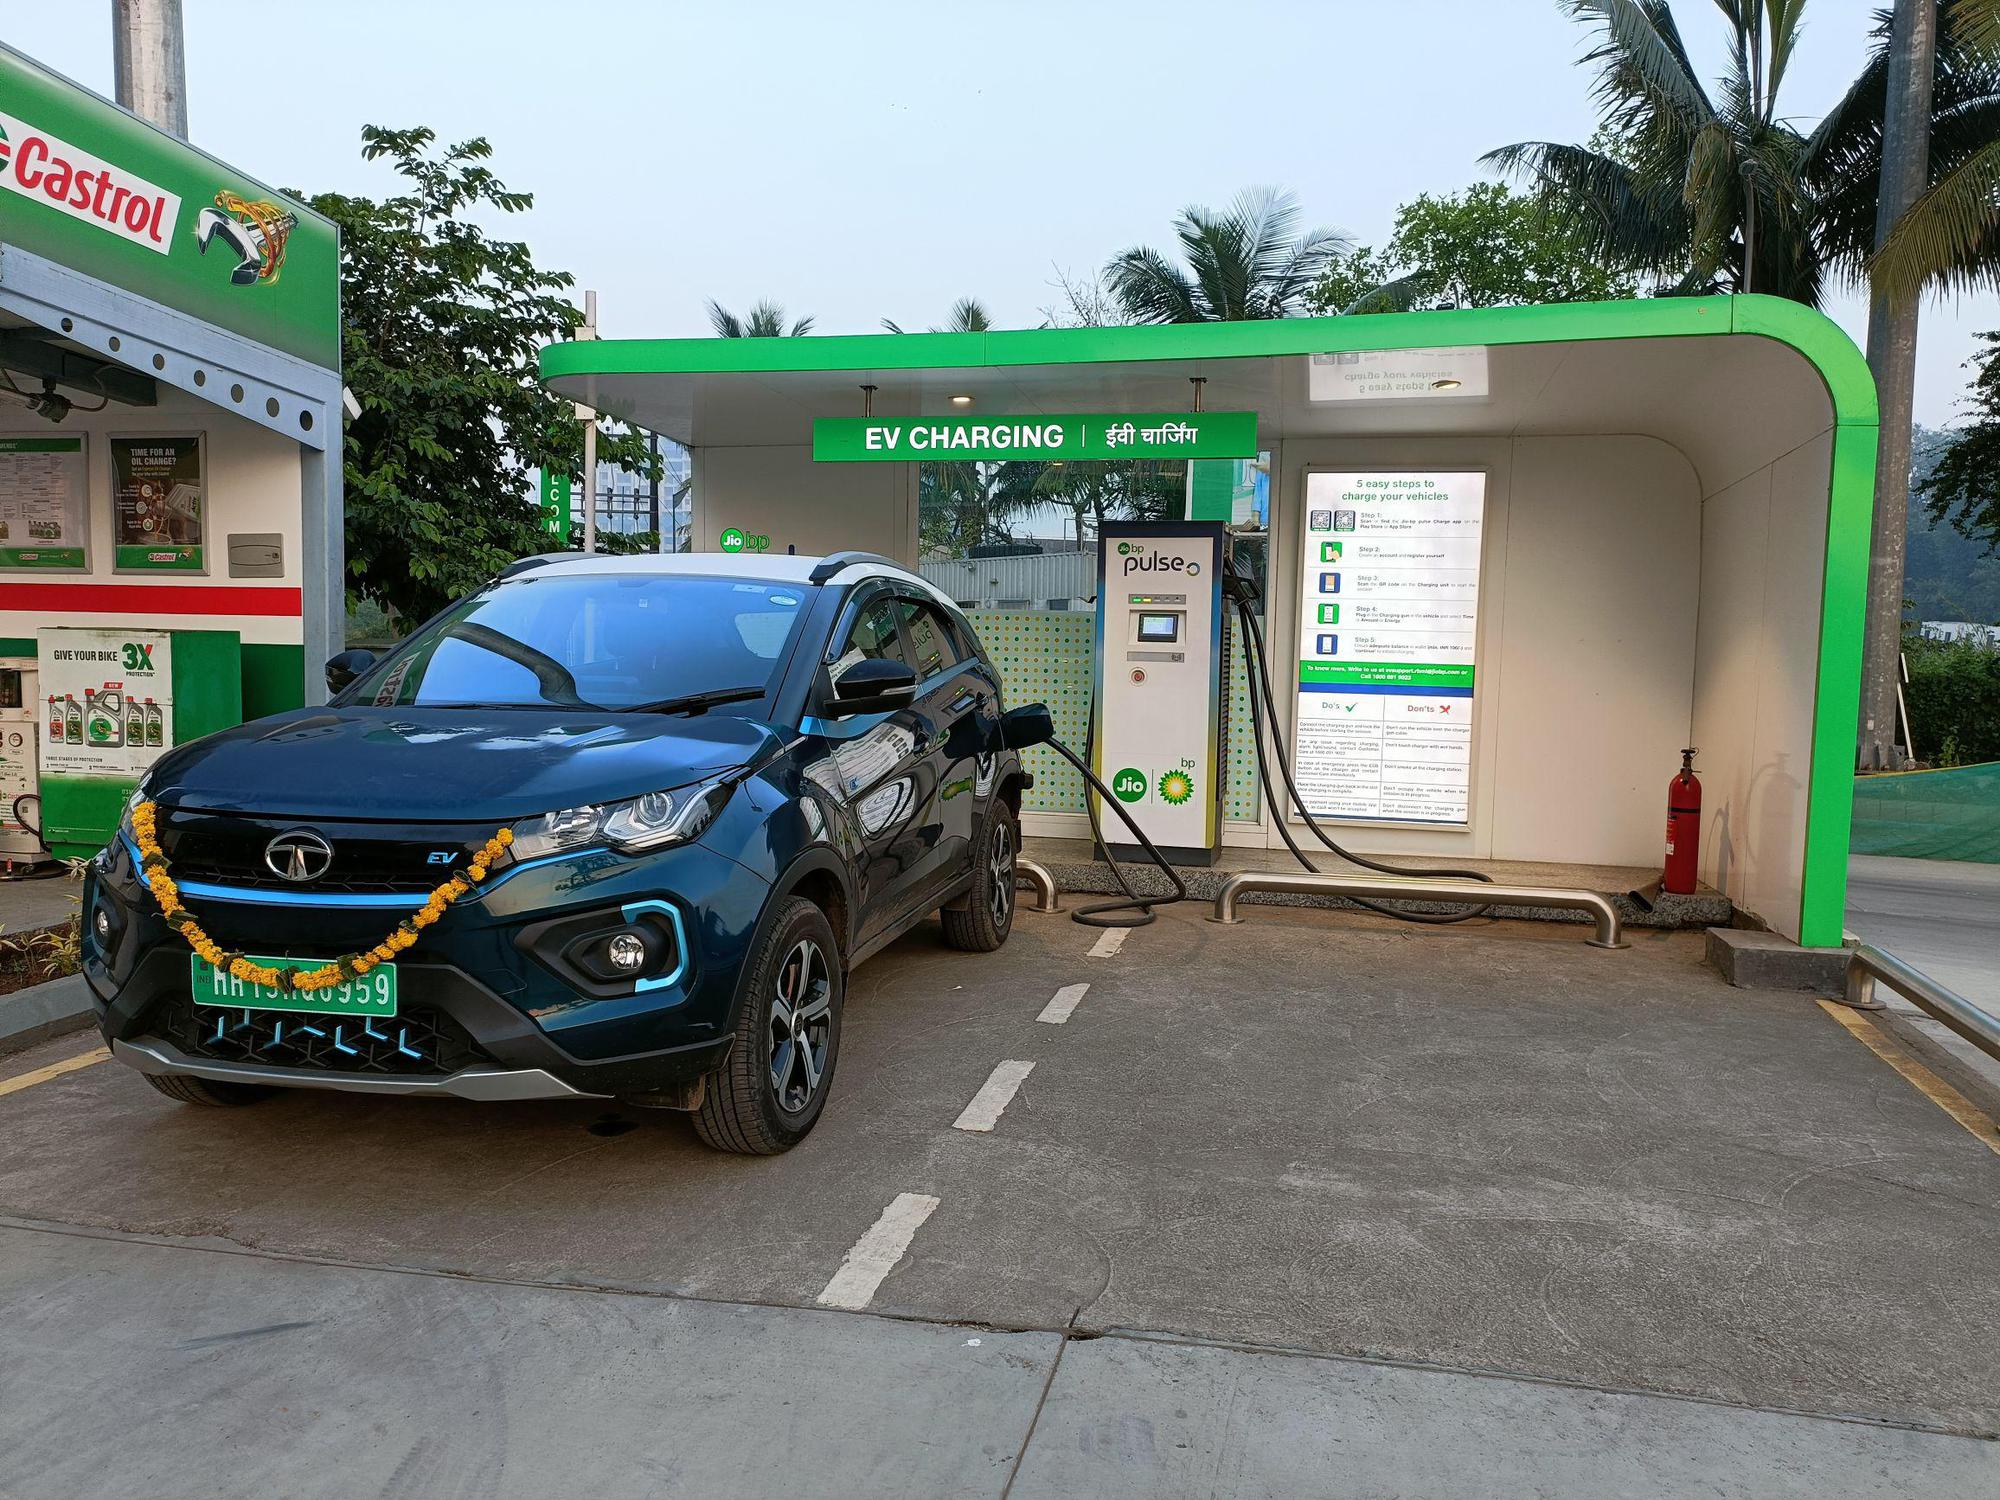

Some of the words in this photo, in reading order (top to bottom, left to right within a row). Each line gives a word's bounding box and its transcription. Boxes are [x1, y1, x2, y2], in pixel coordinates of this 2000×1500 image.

[14, 137, 165, 243] Castrol
[865, 427, 901, 450] EV
[909, 424, 1064, 449] CHARGING
[1105, 423, 1136, 448] ईवी
[1140, 422, 1198, 444] चार्जिंग
[1366, 481, 1389, 489] easy
[1393, 480, 1421, 489] steps
[1342, 492, 1377, 502] charge
[1380, 493, 1403, 502] your
[1406, 492, 1449, 500] vehicles
[723, 535, 741, 545] Jio
[746, 531, 770, 553] bp
[1119, 544, 1129, 552] Jio
[1131, 544, 1144, 554] bp
[1124, 550, 1184, 576] pulse
[1356, 605, 1371, 613] Step
[54, 650, 72, 660] GIVE
[74, 651, 96, 661] YOUR
[98, 651, 118, 661] BIKE
[122, 643, 154, 670] 3X
[1181, 758, 1195, 770] bp
[1117, 777, 1143, 792] Jio
[427, 851, 458, 864] EV
